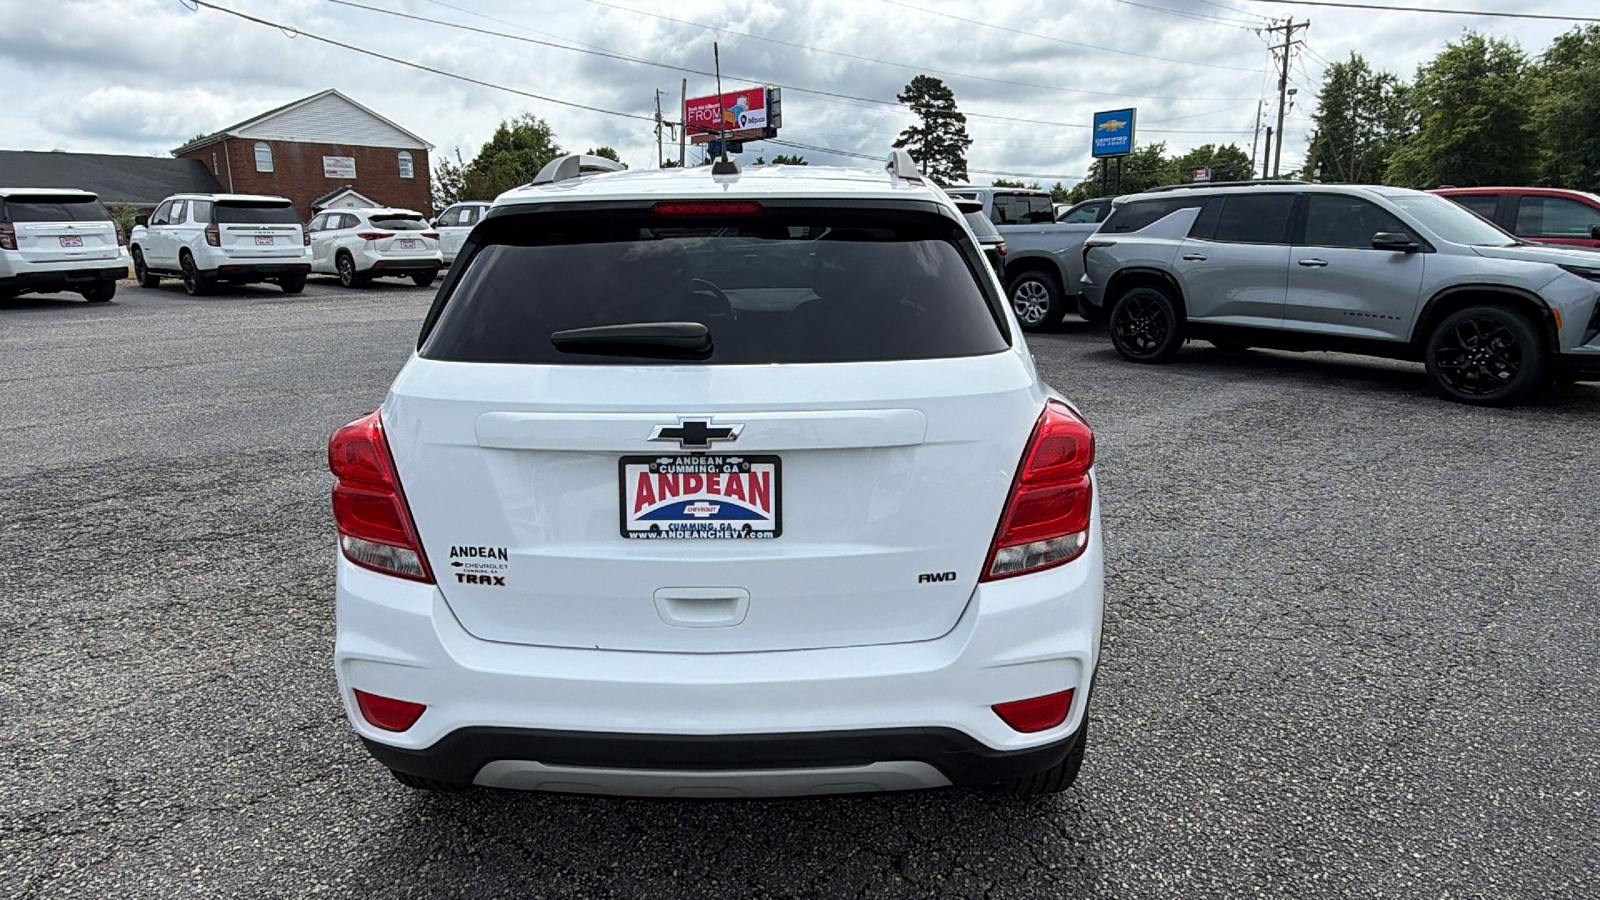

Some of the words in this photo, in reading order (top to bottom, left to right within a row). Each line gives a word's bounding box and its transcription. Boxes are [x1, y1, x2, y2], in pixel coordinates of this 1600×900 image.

[688, 108, 721, 122] FROM
[675, 457, 723, 465] ANDEAN
[659, 465, 719, 473] CUMMING,
[723, 465, 739, 473] GA
[634, 471, 770, 514] ANDEAN
[668, 523, 717, 531] CUMMING,
[629, 531, 774, 539] www.ANDEANCHEVY.com
[450, 546, 508, 561] ANDEAN
[455, 573, 505, 586] TRAX
[918, 571, 957, 584] AWD
